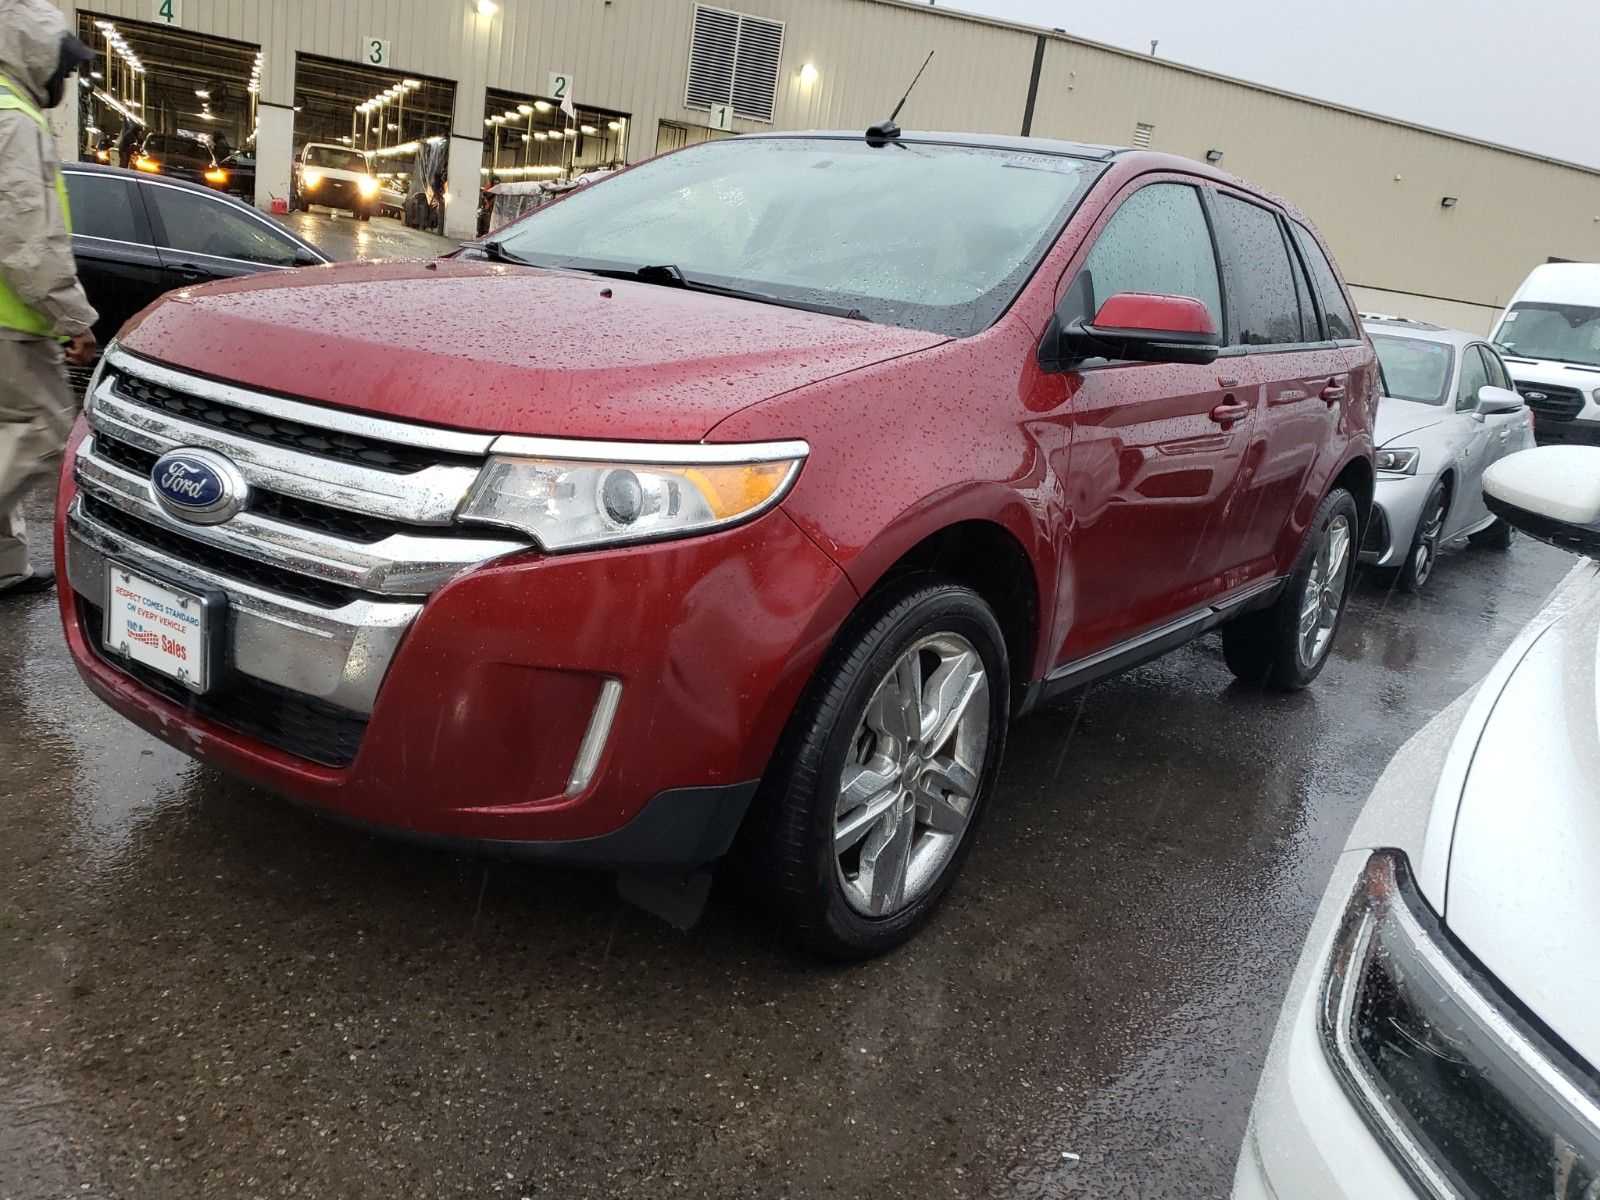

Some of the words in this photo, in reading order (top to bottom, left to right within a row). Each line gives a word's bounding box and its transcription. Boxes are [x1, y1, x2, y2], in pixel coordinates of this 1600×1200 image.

[159, 0, 174, 22] 4
[370, 40, 383, 64] 3
[554, 76, 566, 98] 2
[718, 107, 726, 128] 1
[161, 461, 208, 498] Ford
[115, 586, 141, 603] RESPECT
[142, 597, 164, 612] COMES
[165, 606, 199, 627] STANDARD
[127, 603, 137, 612] ON
[137, 607, 158, 622] EVERY
[159, 616, 187, 634] VEHICLE
[161, 634, 187, 661] Sales
